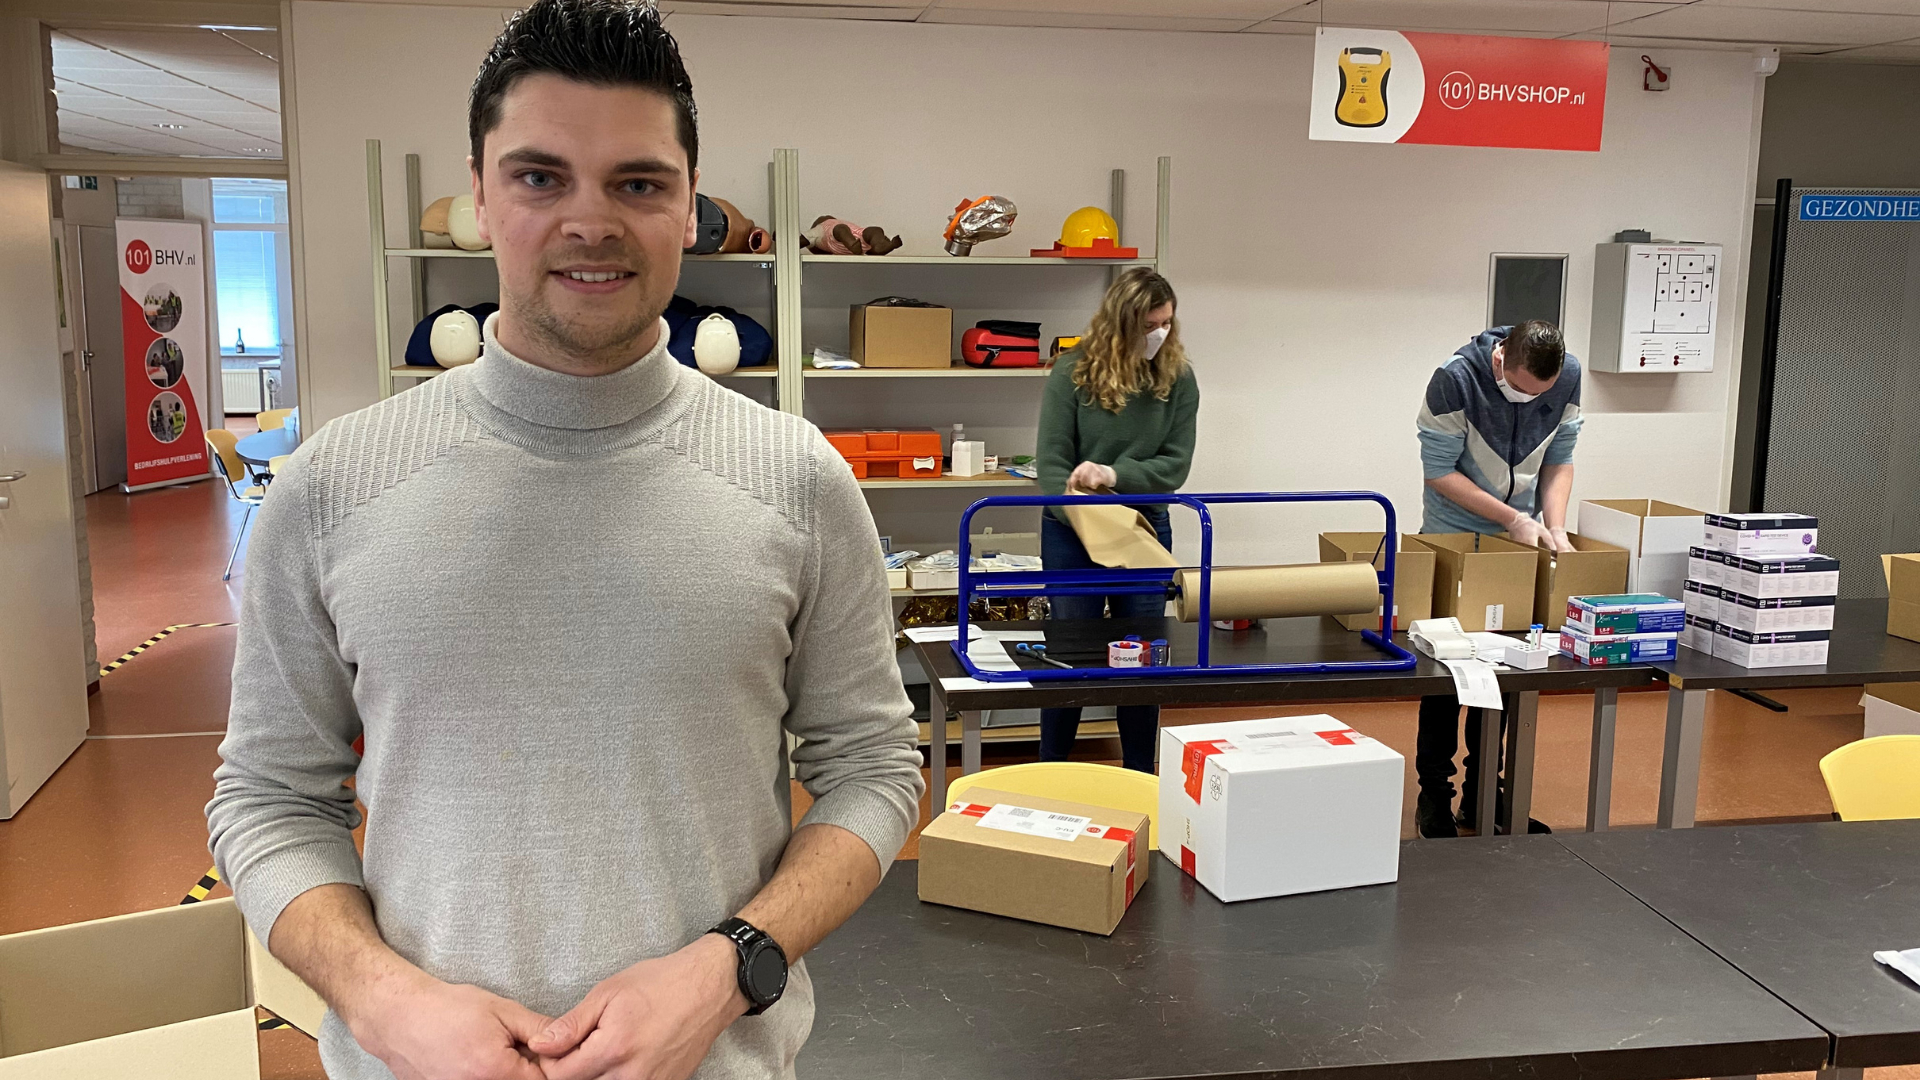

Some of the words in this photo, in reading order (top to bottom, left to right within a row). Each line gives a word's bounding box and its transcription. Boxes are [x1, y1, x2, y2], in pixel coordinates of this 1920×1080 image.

[1442, 81, 1471, 100] 101
[1478, 83, 1585, 105] BHVSHOP.nl
[1806, 199, 1920, 217] GEZONDHE
[127, 249, 150, 265] 101
[155, 249, 196, 265] BHV.nl
[134, 453, 202, 470] BEDRIJFSHULPVERLENING
